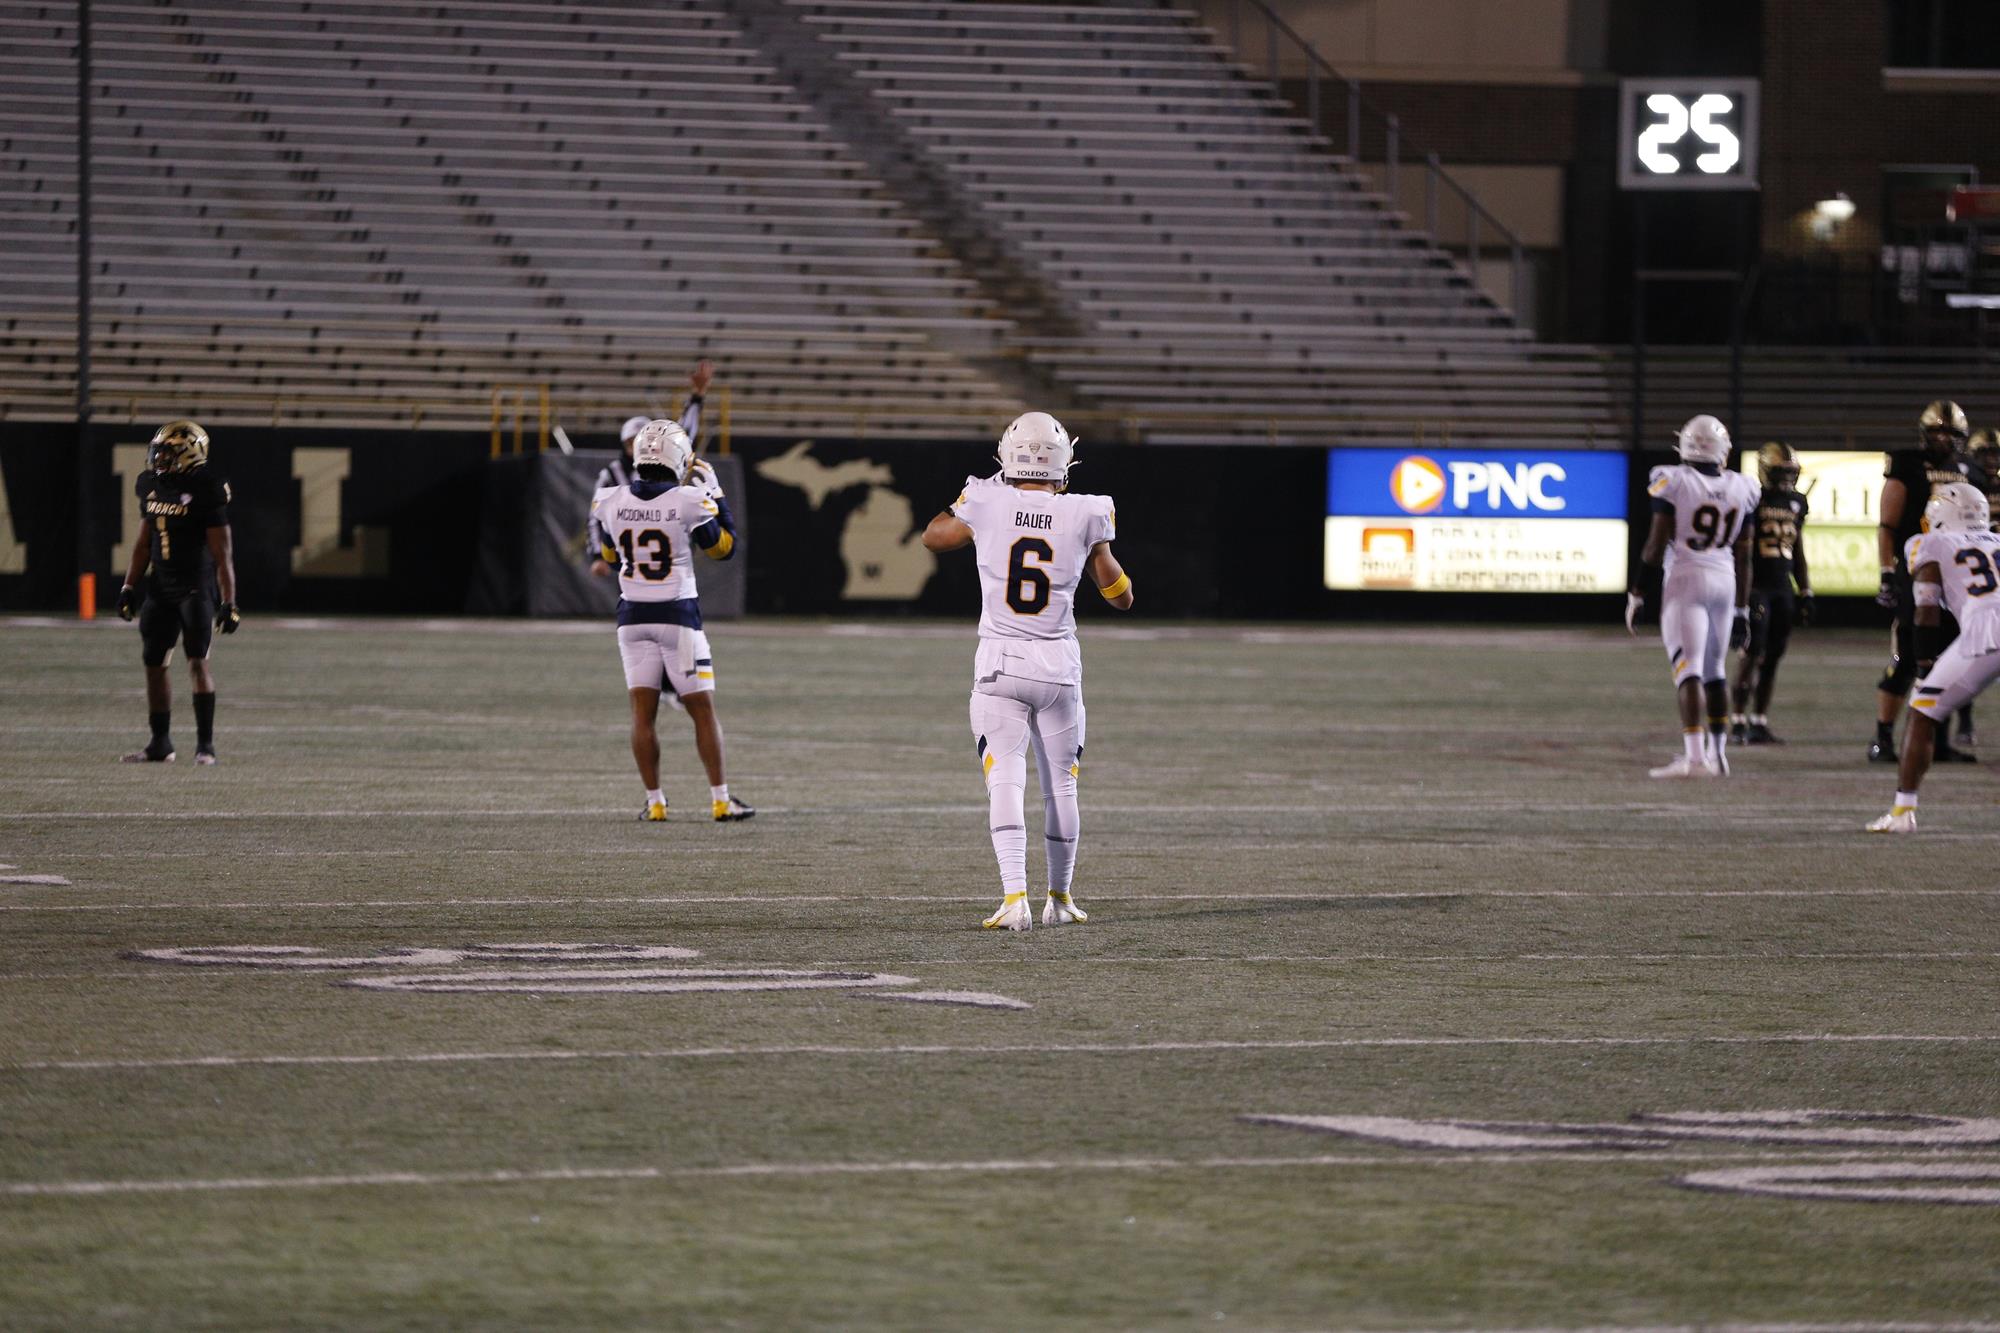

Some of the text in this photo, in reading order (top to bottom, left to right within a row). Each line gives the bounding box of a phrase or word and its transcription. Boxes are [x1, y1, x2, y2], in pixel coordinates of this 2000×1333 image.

[1638, 94, 1739, 173] 25
[1016, 470, 1049, 478] TOLEDO
[1448, 462, 1566, 511] PNC
[617, 508, 661, 522] MCDONALD
[1015, 511, 1052, 530] BAUER
[1686, 504, 1738, 551] 91
[618, 528, 673, 581] 13
[1005, 536, 1053, 616] 6
[1954, 548, 2000, 597] 3
